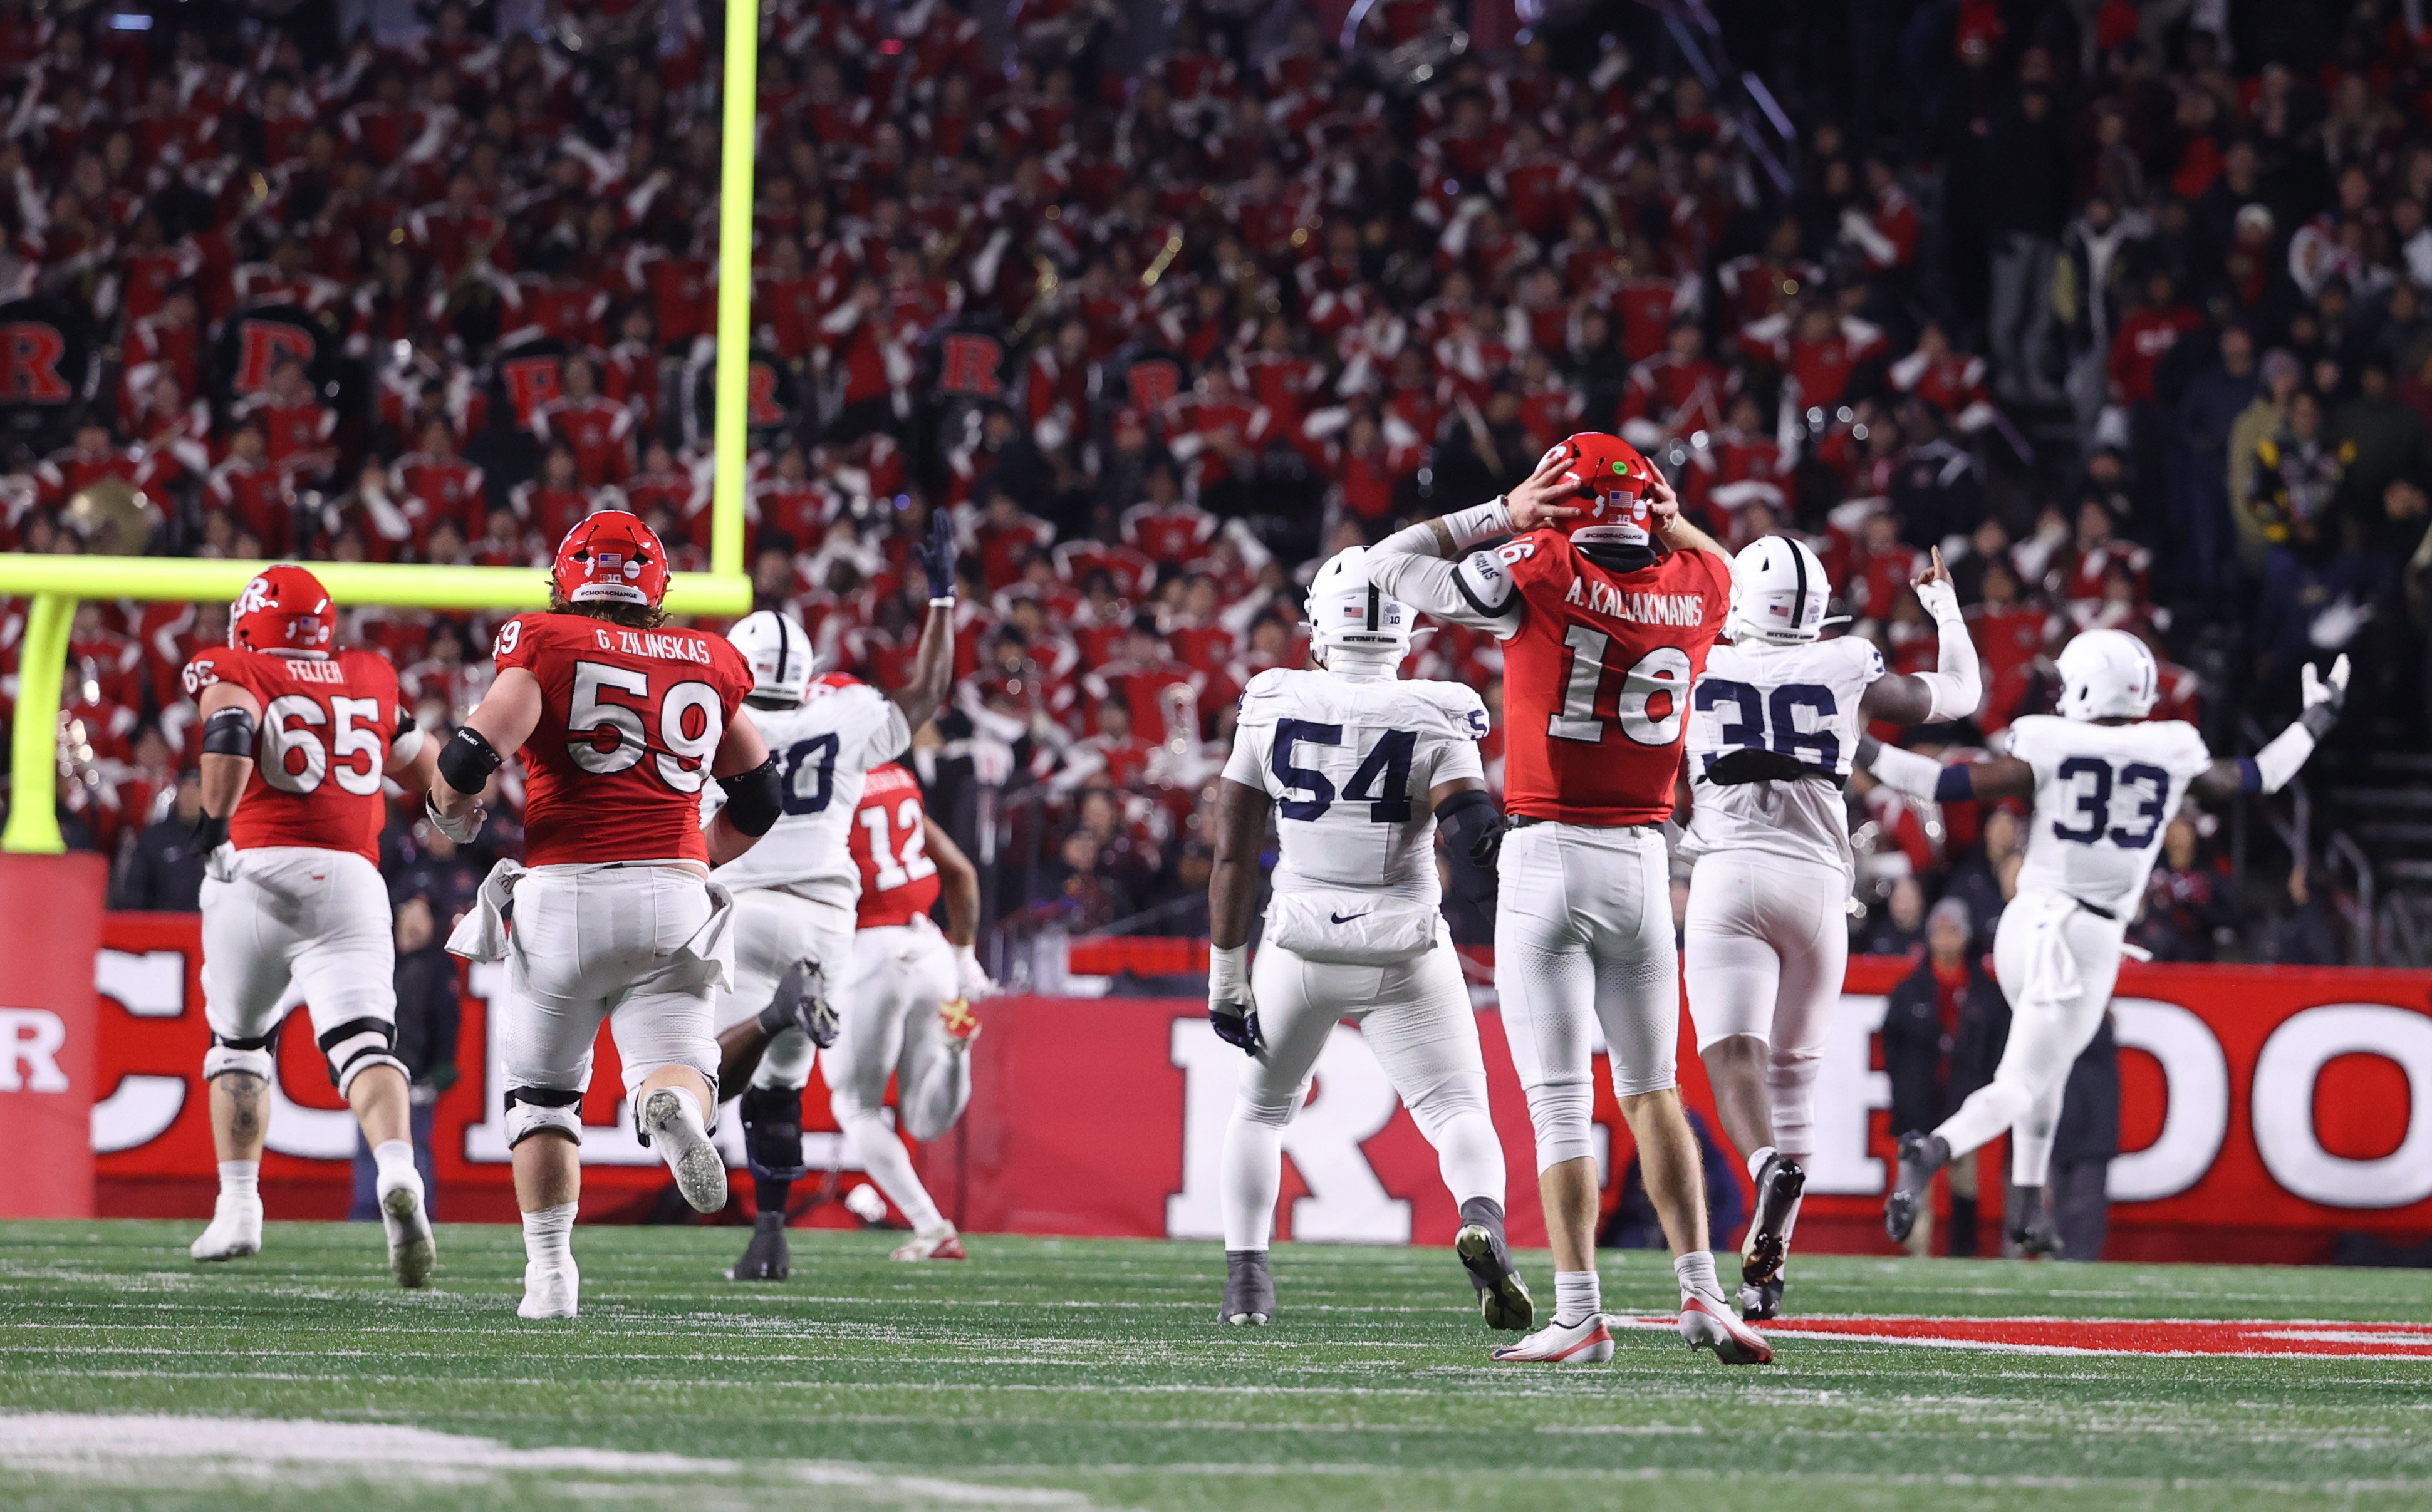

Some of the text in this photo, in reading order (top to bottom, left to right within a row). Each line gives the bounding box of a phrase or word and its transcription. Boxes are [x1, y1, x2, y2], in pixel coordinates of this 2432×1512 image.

[1565, 576, 1585, 607] A.
[181, 660, 219, 695] 65
[596, 629, 711, 665] G. ZILINSKAS
[1547, 624, 1691, 747] 16
[259, 693, 383, 795] 65
[568, 660, 724, 794] 59
[770, 732, 839, 816] 0
[1271, 717, 1419, 824] 54
[1694, 678, 1840, 775] 36
[859, 798, 937, 892] 12
[2053, 757, 2169, 849] 33
[1165, 1016, 1413, 1245] R
